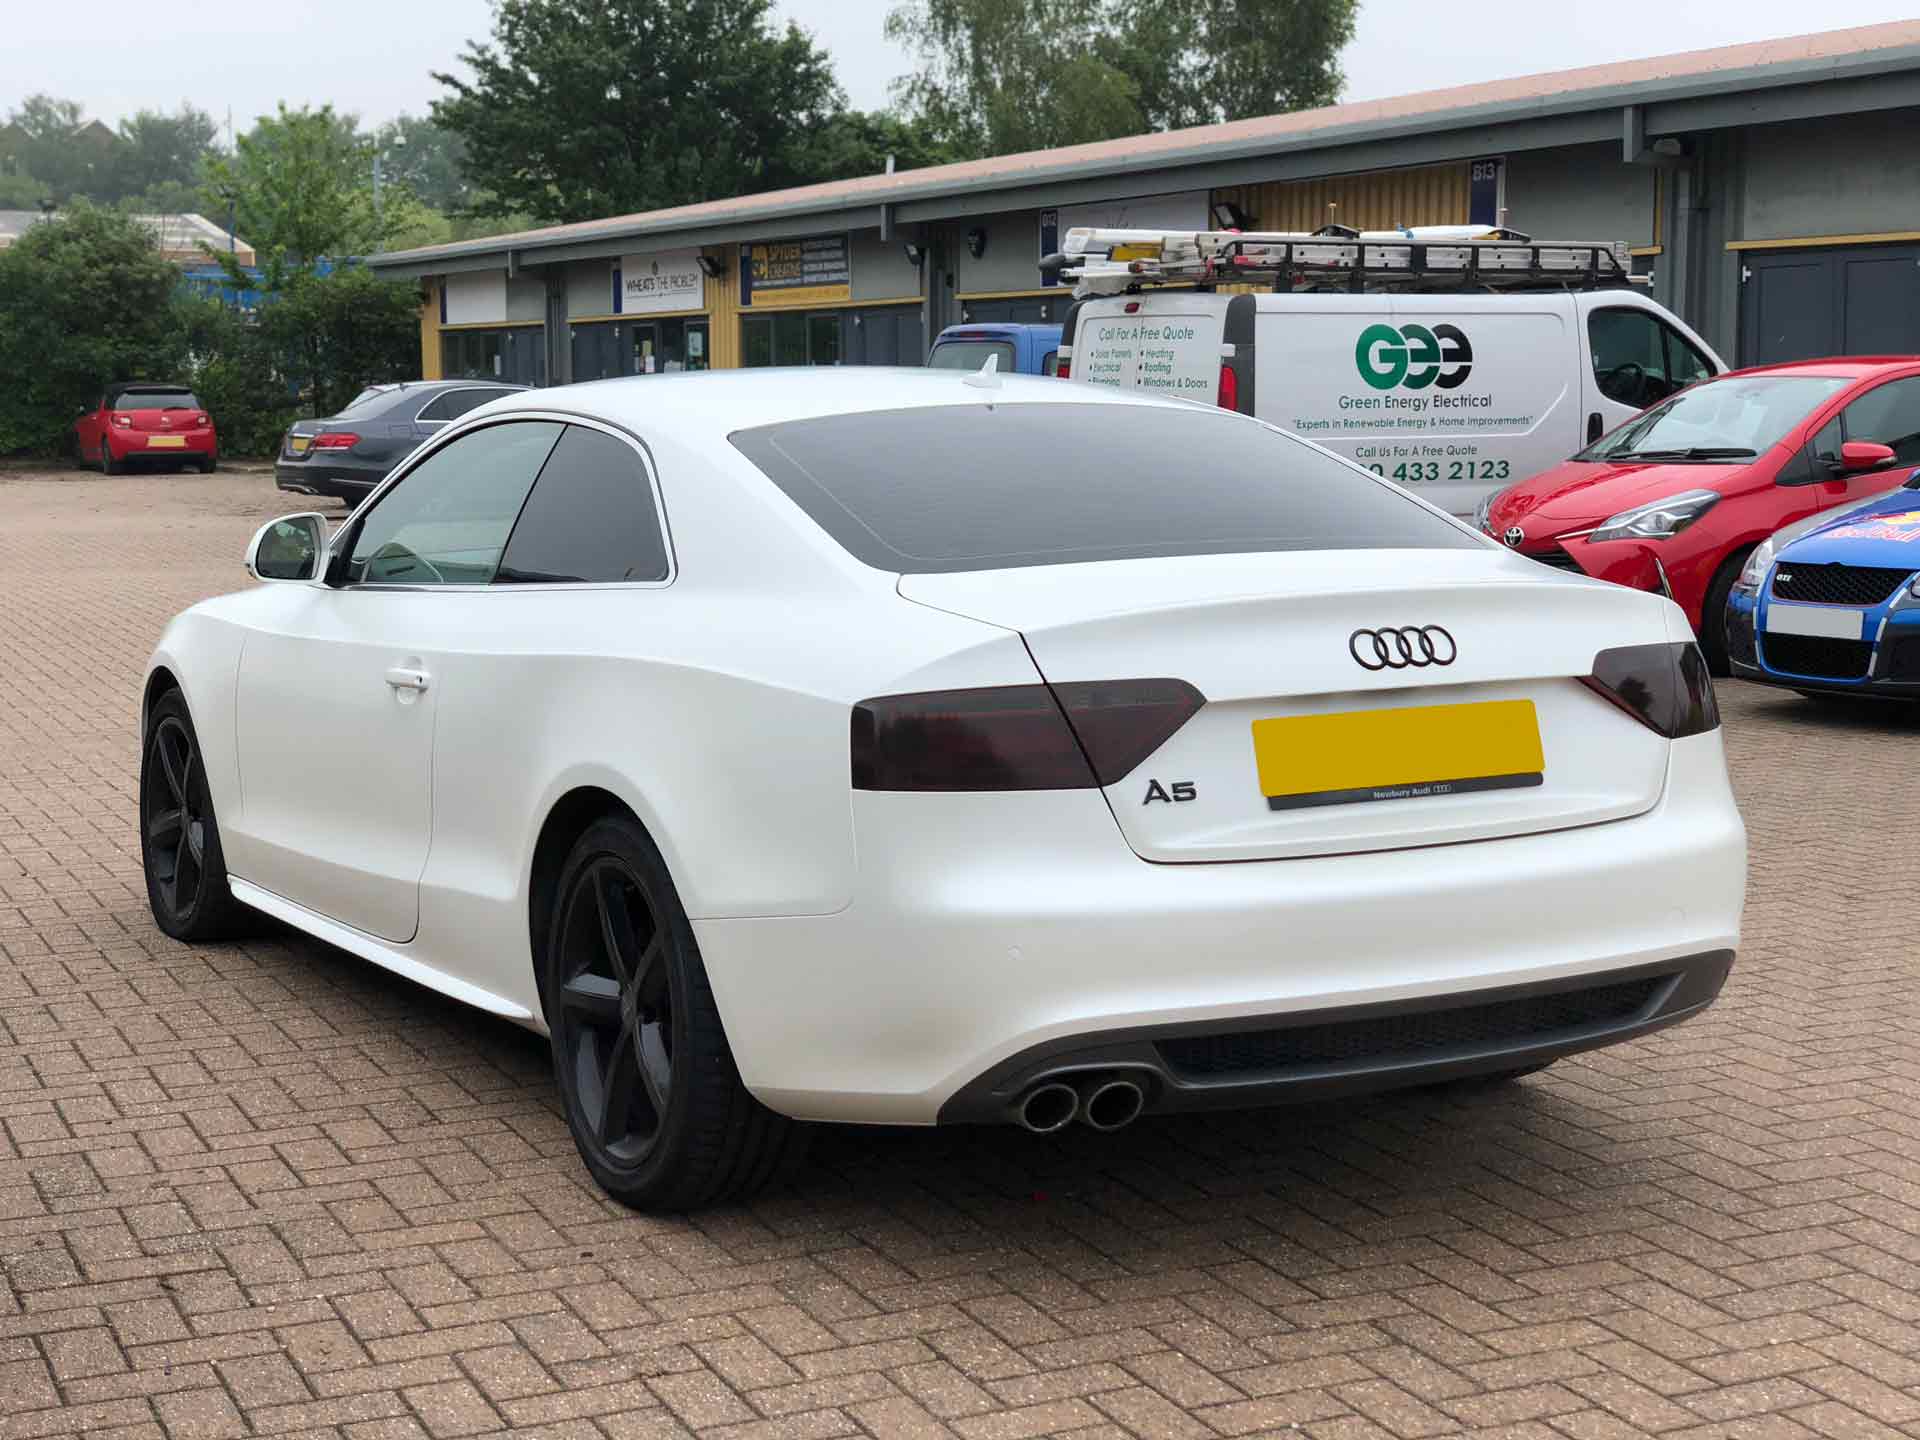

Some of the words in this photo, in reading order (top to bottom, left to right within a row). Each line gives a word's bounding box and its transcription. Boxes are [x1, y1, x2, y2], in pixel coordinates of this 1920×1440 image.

[1099, 328, 1115, 341] Call
[1116, 328, 1130, 340] For
[1131, 328, 1138, 340] A
[1140, 327, 1160, 340] Free
[1163, 326, 1194, 340] Quote
[1146, 349, 1175, 360] Heating
[1145, 362, 1172, 374] Roofing
[1144, 377, 1175, 388] Windows
[1185, 378, 1208, 388] Doors
[1338, 395, 1381, 409] Green
[1385, 395, 1428, 411] Energy
[1433, 394, 1492, 408] Electrical
[1343, 417, 1394, 428] Renewable
[1397, 416, 1427, 428] Energy
[1430, 416, 1436, 426] &
[1439, 416, 1465, 426] Home
[1356, 447, 1376, 458] Call
[1379, 446, 1391, 457] Us
[1393, 446, 1408, 456] For
[1411, 446, 1419, 456] A
[1422, 446, 1443, 456] Free
[1446, 445, 1478, 456] Quote
[1392, 462, 1439, 481] 433
[1448, 460, 1510, 481] 2123
[1142, 778, 1197, 806] A5
[1412, 786, 1431, 795] Audi
